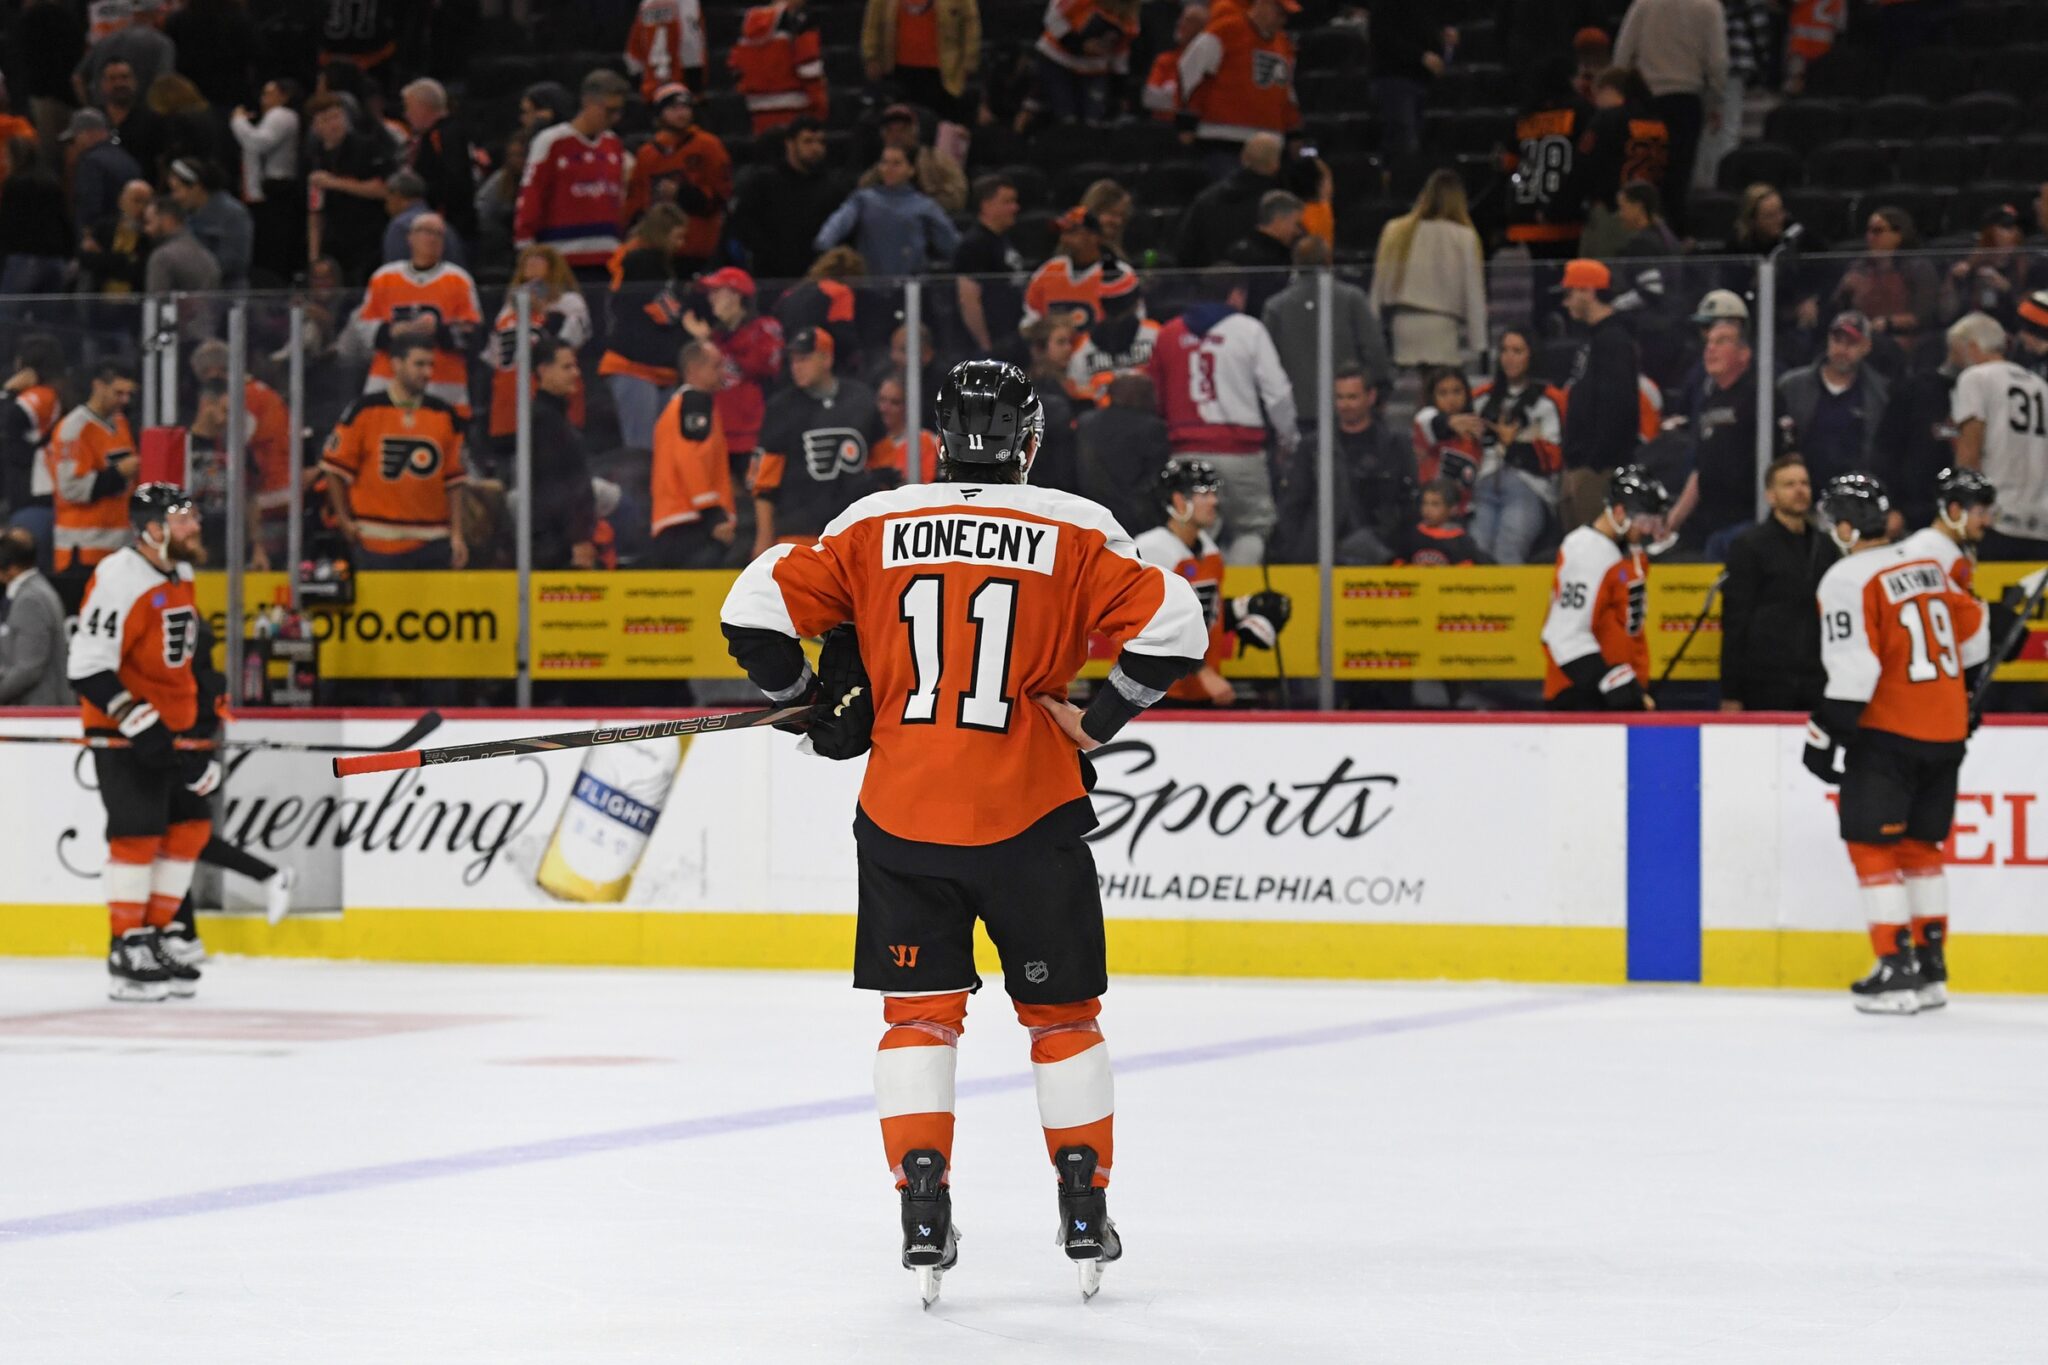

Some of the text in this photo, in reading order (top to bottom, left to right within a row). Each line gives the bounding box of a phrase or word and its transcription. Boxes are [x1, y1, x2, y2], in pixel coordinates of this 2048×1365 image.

[647, 25, 672, 79] 4
[2008, 386, 2046, 435] 31
[968, 434, 984, 450] 11
[892, 519, 1045, 564] KONECNY
[88, 608, 118, 638] 44
[1825, 611, 1852, 642] 19
[1900, 598, 1960, 683] 19
[898, 573, 1019, 734] 11
[576, 777, 654, 827] FLIGHT
[1080, 741, 1398, 865] Sports
